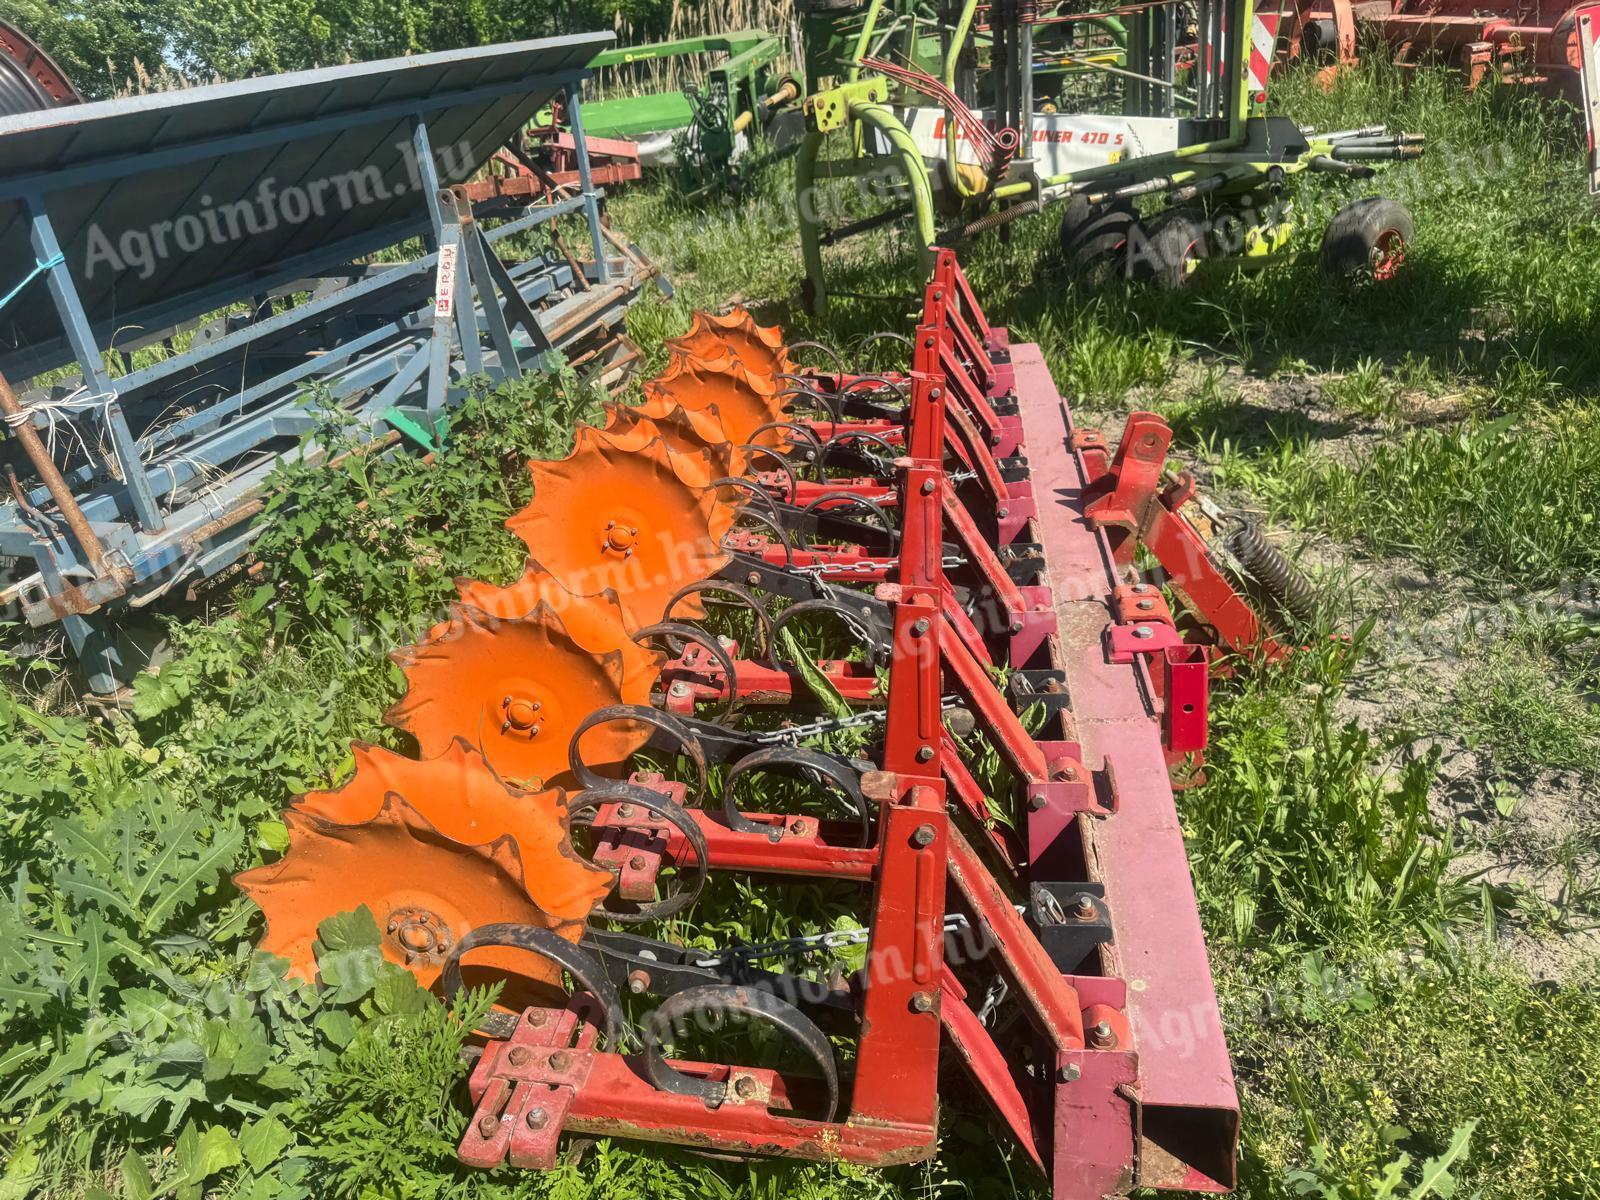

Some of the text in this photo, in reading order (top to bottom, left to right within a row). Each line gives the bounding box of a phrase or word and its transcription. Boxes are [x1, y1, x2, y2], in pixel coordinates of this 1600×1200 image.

[1032, 130, 1124, 146] LINER 470 S
